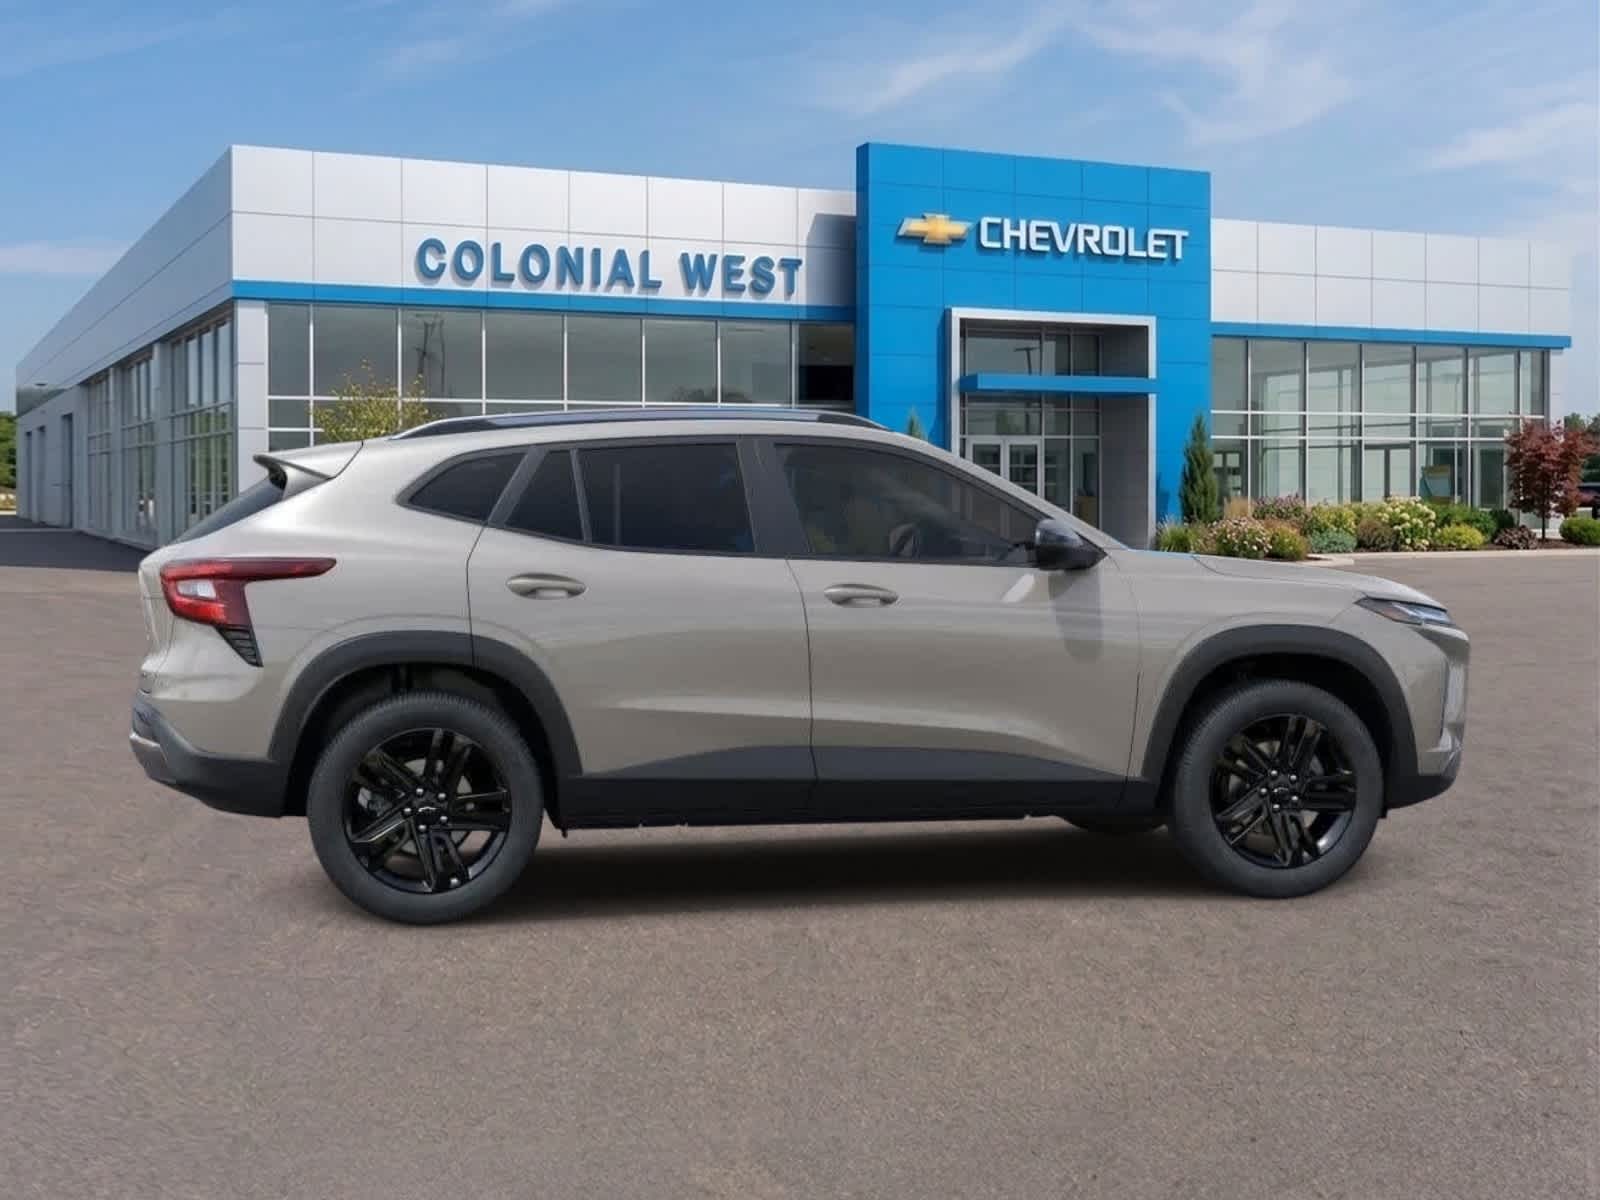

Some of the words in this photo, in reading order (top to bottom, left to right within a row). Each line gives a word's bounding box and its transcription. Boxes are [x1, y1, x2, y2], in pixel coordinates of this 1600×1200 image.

[979, 216, 1190, 261] CHEVROLET
[416, 237, 662, 289] COLONIAL
[679, 252, 803, 296] WEST
